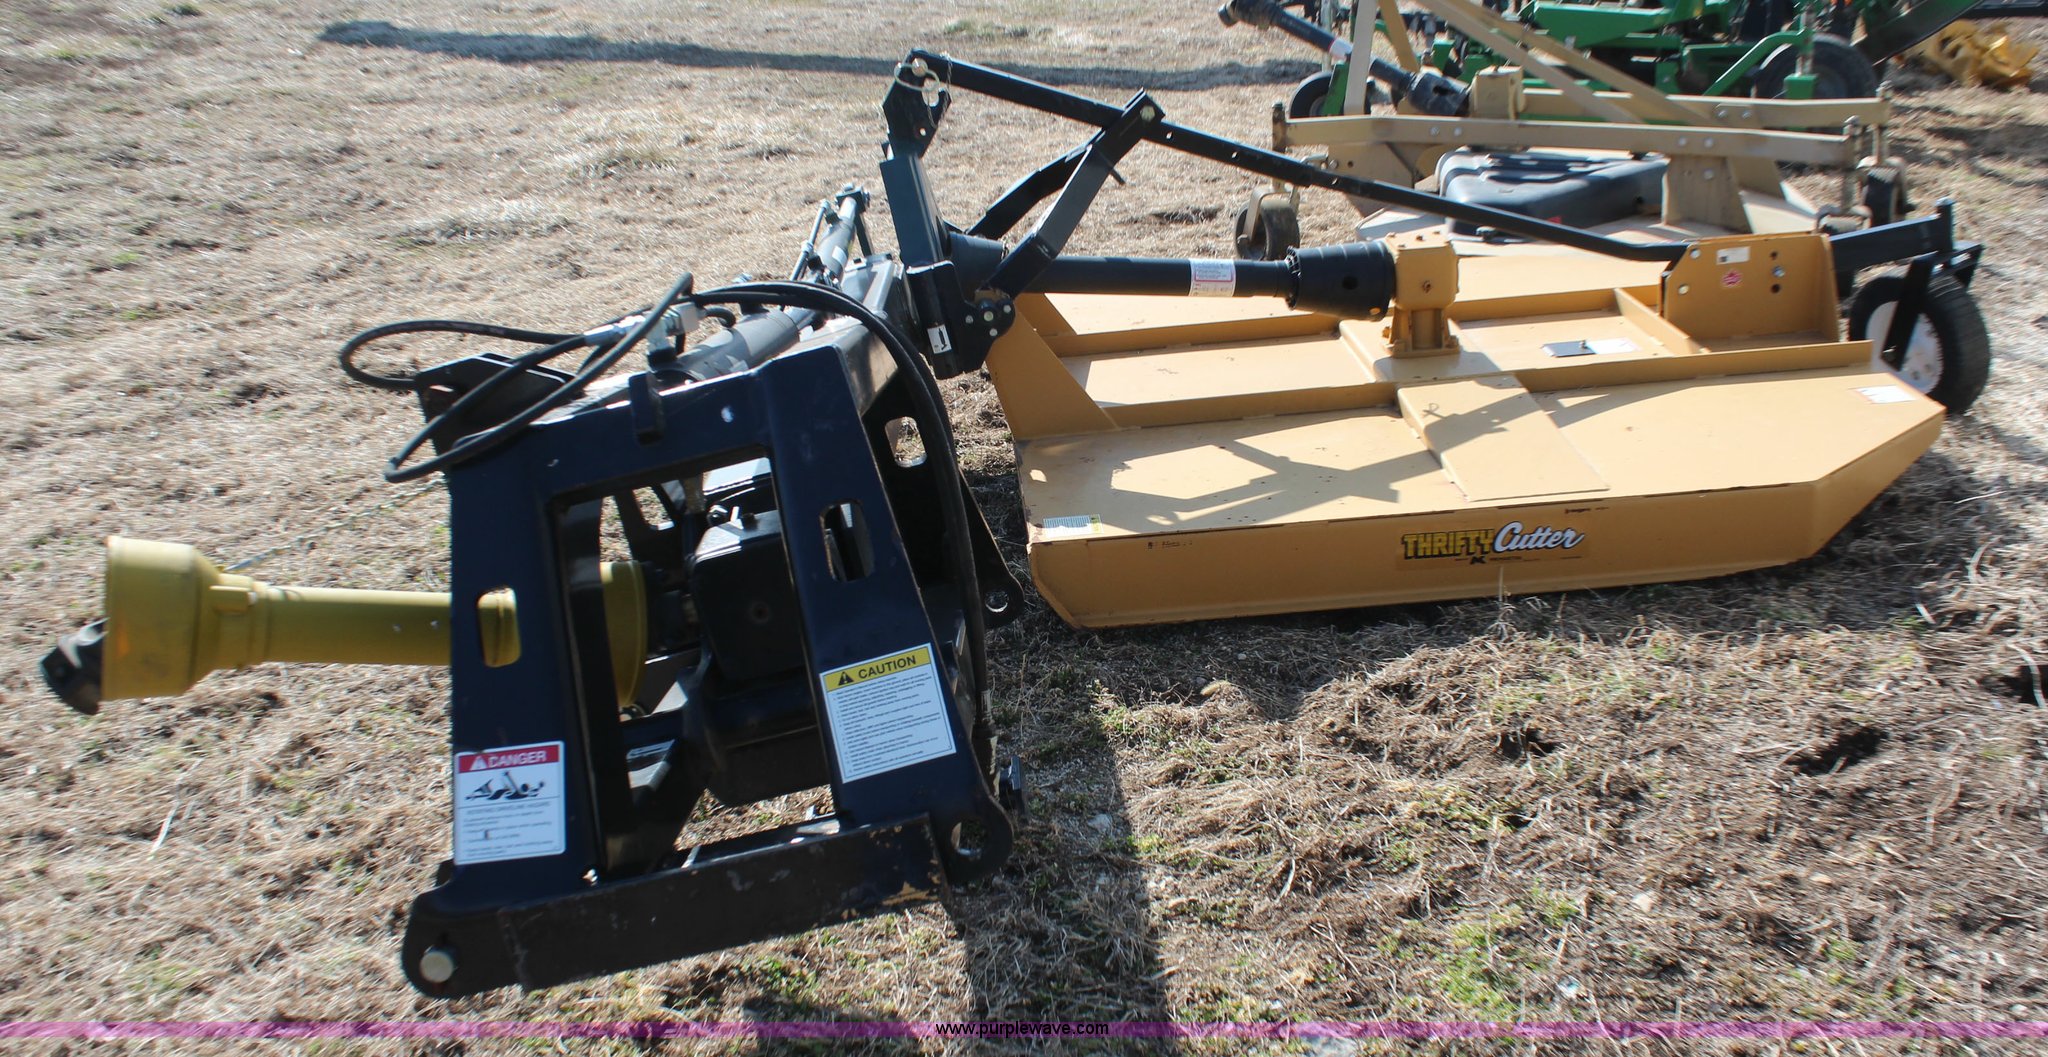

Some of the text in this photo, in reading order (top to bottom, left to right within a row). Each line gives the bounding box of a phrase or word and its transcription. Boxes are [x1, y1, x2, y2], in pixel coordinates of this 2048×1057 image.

[1402, 520, 1585, 560] THRIFTY Cutter
[858, 655, 917, 680] CAUTION
[488, 750, 548, 768] DANGER
